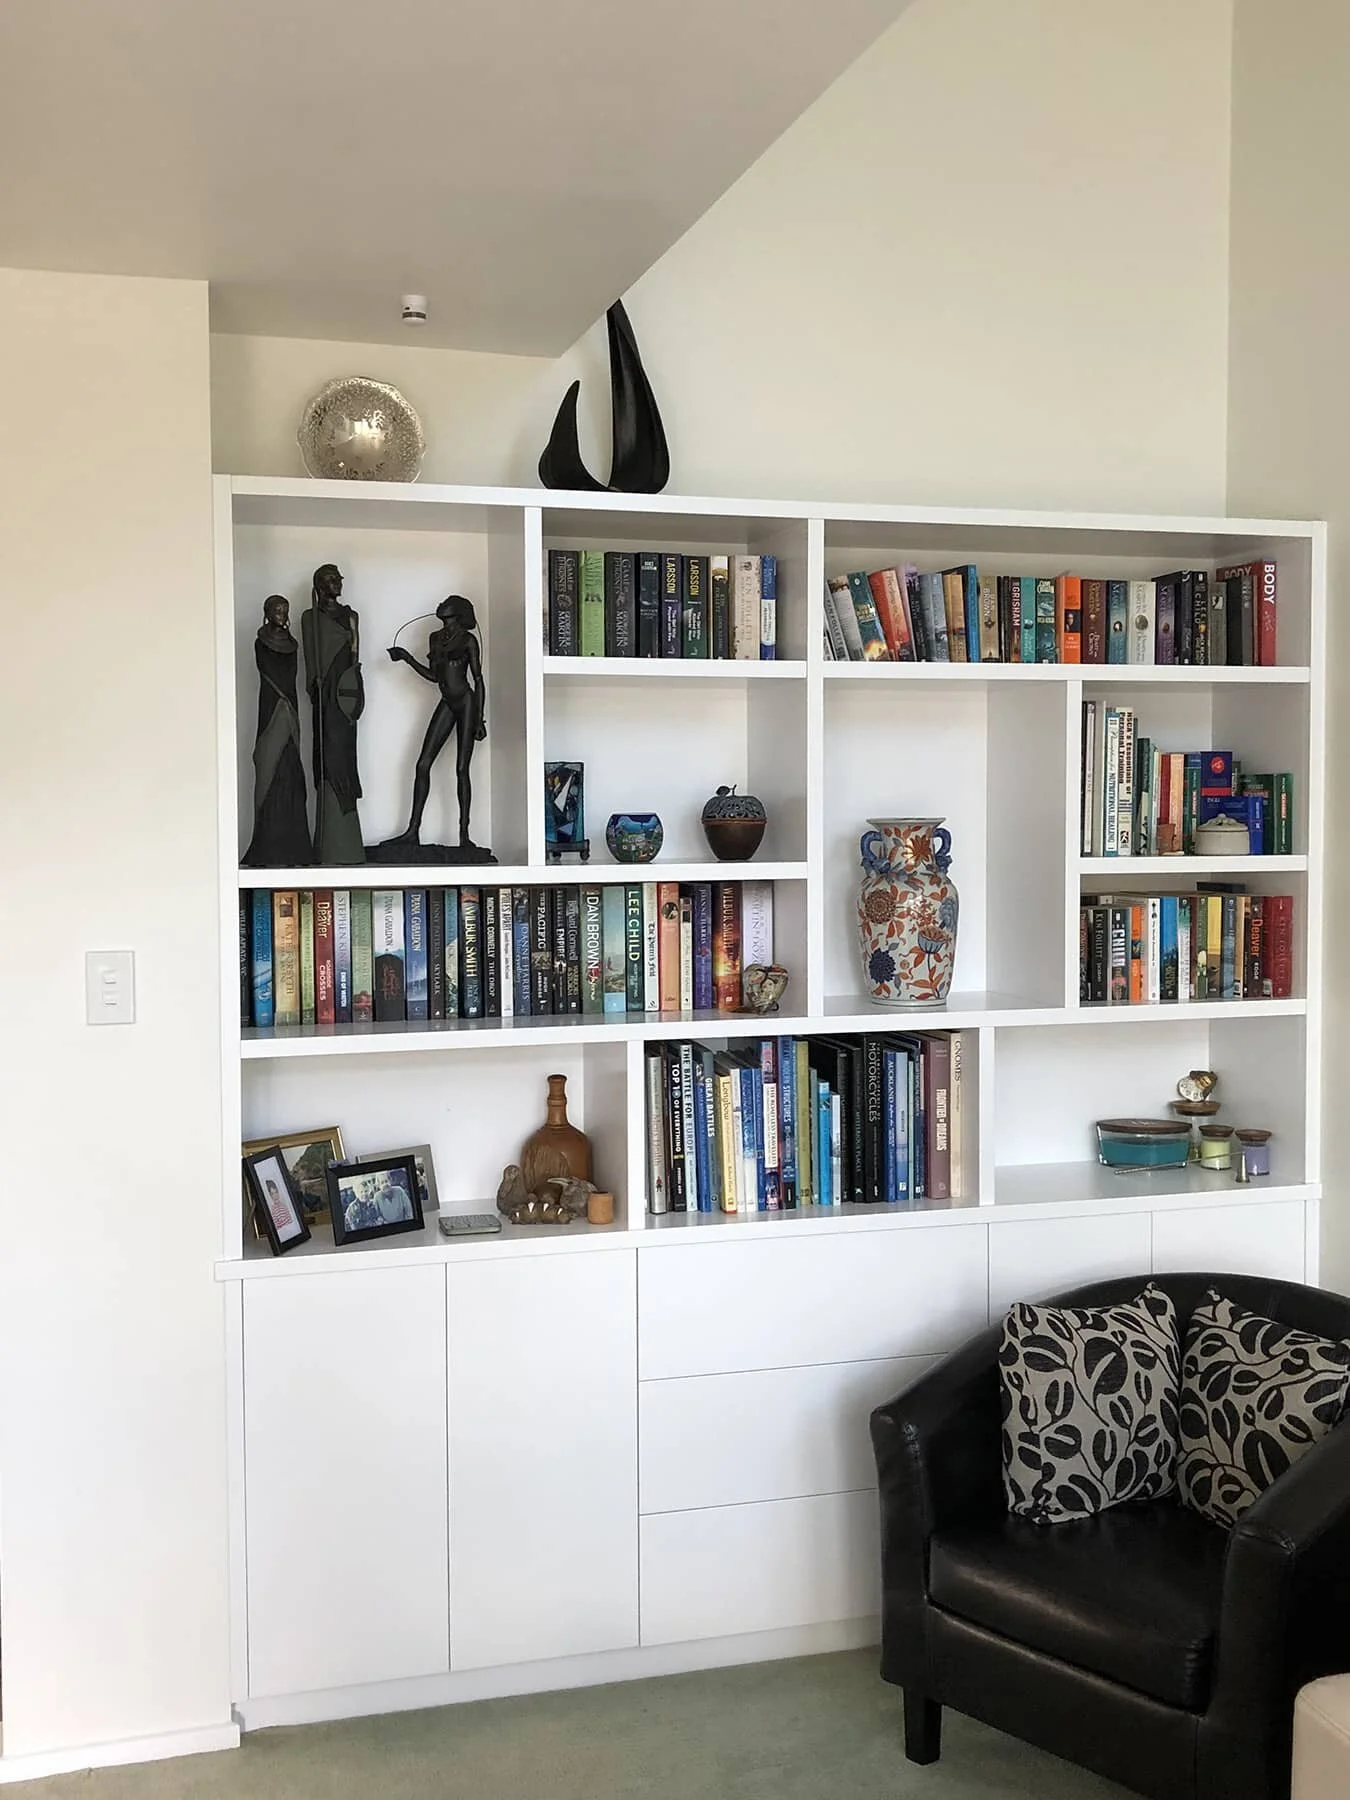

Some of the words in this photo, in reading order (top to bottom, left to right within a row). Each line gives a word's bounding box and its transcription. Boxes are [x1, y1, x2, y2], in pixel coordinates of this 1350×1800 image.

[666, 557, 676, 594] LARSSON
[689, 559, 700, 595] LARSSON
[1263, 564, 1275, 604] BODY
[982, 588, 991, 617] BROWN
[1011, 586, 1020, 627] GRISHAM
[558, 611, 567, 648] MARTIN
[616, 611, 625, 648] MARTIN
[831, 615, 844, 647] FOLLETT
[1108, 773, 1116, 814] NUTRITIONAL
[1107, 815, 1116, 843] HEALING
[338, 897, 347, 939] STEPHEN
[384, 895, 394, 915] DIANA
[410, 894, 422, 915] DIANA
[486, 897, 495, 926] MICHAEL
[566, 900, 578, 929] Bernard
[586, 896, 600, 922] DAN
[628, 890, 641, 916] LEE
[722, 887, 734, 922] WILBUR
[317, 902, 330, 938] Deaver
[384, 915, 394, 946] GABALDON
[410, 916, 422, 951] GABALDON
[464, 904, 477, 945] WILBUR
[537, 907, 546, 949] PACIFIC
[722, 923, 734, 949] SMITH
[1095, 913, 1104, 929] KEN
[338, 942, 347, 966] KING
[486, 926, 495, 958] CONNELLY
[556, 928, 565, 959] EMPIRE
[568, 929, 579, 961] Cornwell
[586, 924, 600, 969] BROWN
[628, 918, 641, 961] CHILD
[1095, 929, 1104, 958] FOLLETT
[1112, 928, 1126, 967] CHILD
[1250, 919, 1263, 957] Deaver
[465, 946, 478, 977] SMITH
[521, 964, 530, 1000] HARRIS
[682, 1048, 691, 1064] THE
[953, 1041, 962, 1082] GNOMES
[671, 1063, 680, 1084] TOP
[683, 1068, 692, 1099] BATTLE
[868, 1042, 877, 1122] MOTORCYCLES
[673, 1100, 680, 1108] OF
[704, 1077, 714, 1103] GREAT
[721, 1081, 732, 1121] Longbow
[782, 1085, 792, 1122] STRUCTURES
[936, 1089, 947, 1119] FRONTIER
[684, 1102, 693, 1119] FOR
[705, 1104, 715, 1138] BATTLES
[673, 1110, 682, 1153] EVERYTHING
[685, 1123, 694, 1156] EUROPE
[936, 1123, 947, 1151] DREAMS
